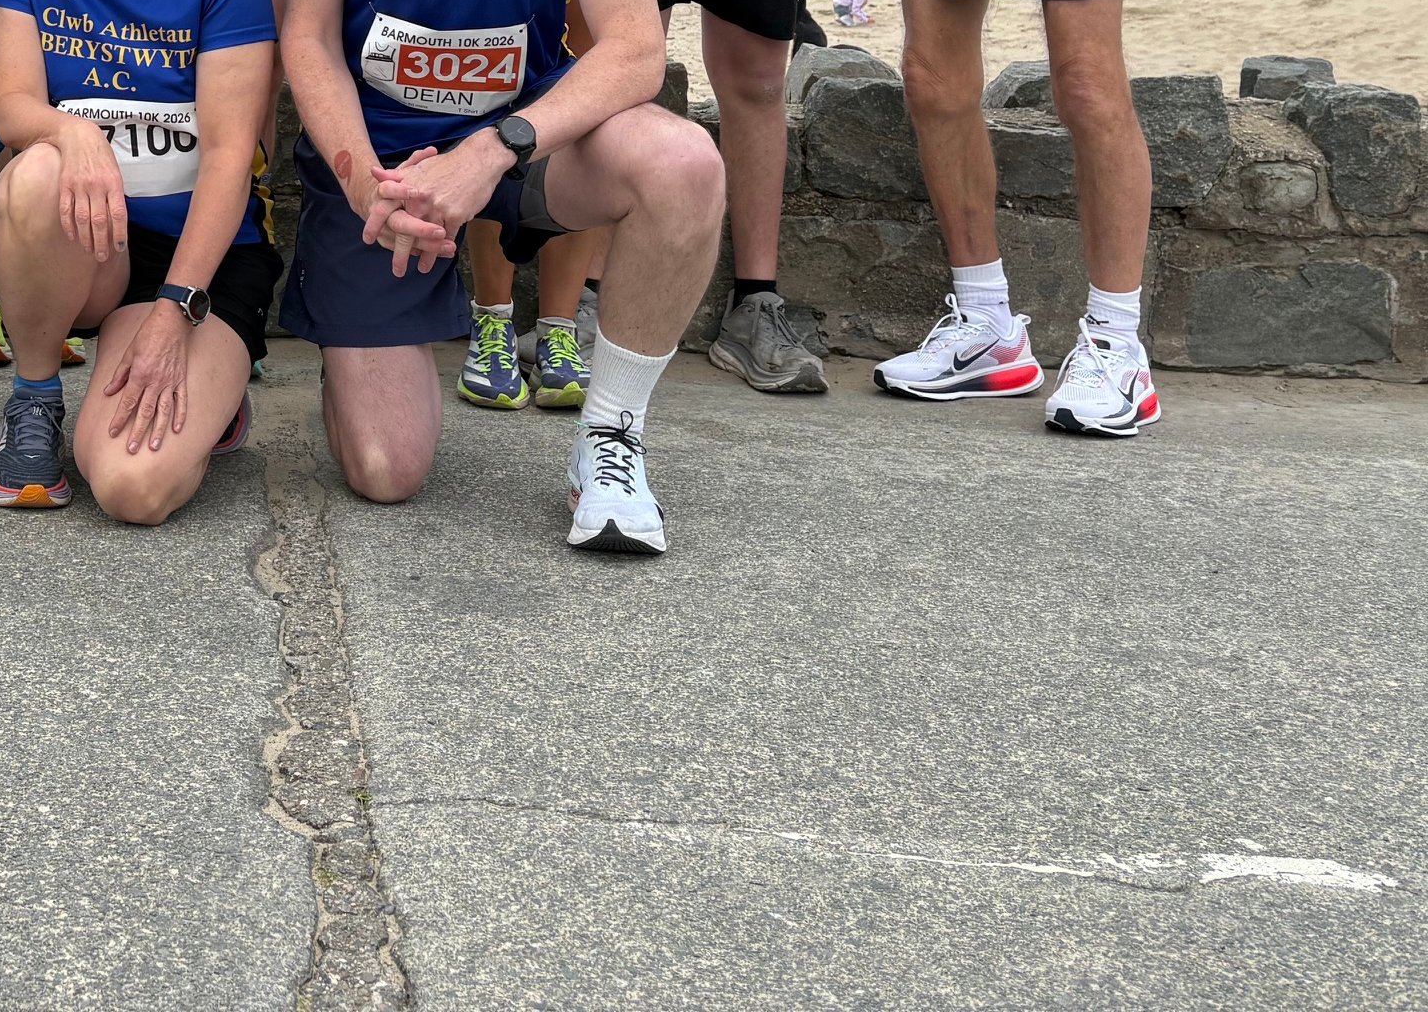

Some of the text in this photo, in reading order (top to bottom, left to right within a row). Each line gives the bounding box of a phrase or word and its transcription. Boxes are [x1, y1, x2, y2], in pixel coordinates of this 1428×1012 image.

[43, 6, 192, 44] Clwb Athletau
[381, 26, 514, 48] BARMOUTH 10K 2026
[403, 51, 516, 84] 3024
[83, 67, 137, 92] A.C.
[404, 87, 474, 106] DEIAN
[139, 112, 159, 122] 10K
[163, 112, 191, 124] 2026
